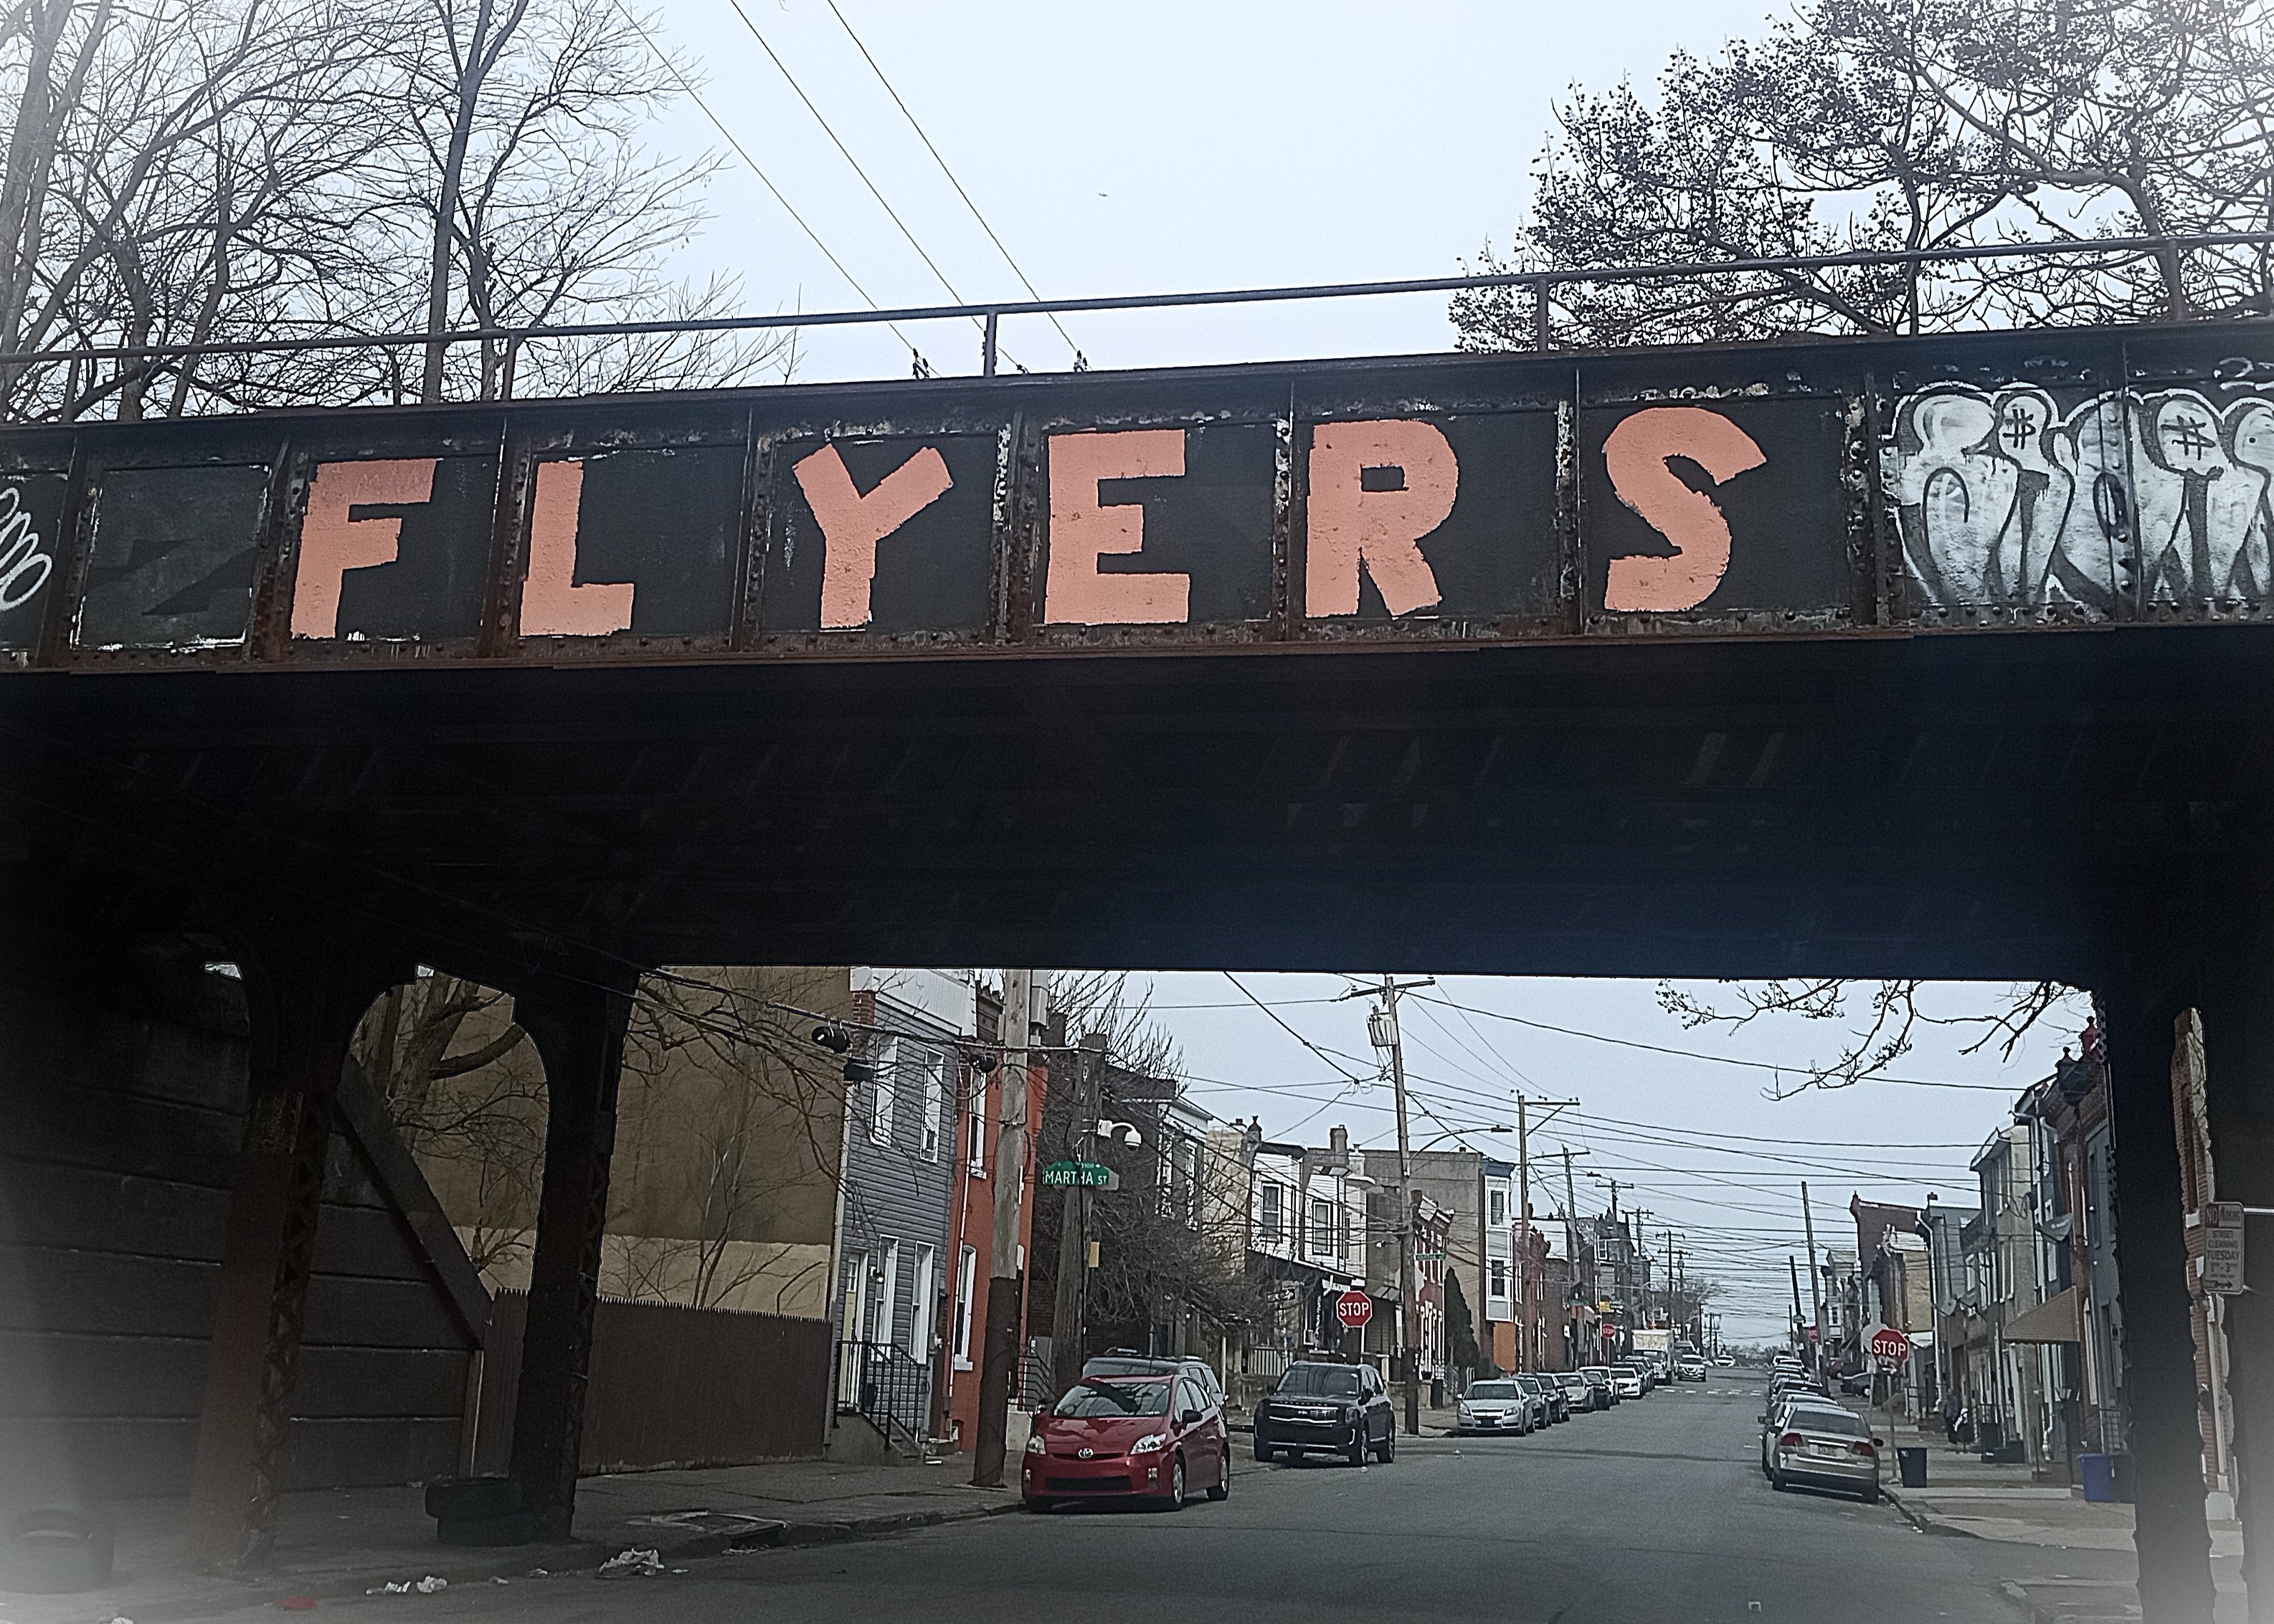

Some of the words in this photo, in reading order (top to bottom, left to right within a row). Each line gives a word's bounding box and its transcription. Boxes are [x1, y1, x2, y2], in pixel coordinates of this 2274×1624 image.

[290, 406, 1766, 640] FLYERS
[1045, 1170, 1094, 1185] MARTHA
[1097, 1175, 1107, 1185] ST
[2206, 1207, 2217, 1223] NO
[2212, 1230, 2233, 1238] STREET
[2208, 1240, 2239, 1249] CLEANING
[2207, 1250, 2240, 1261] TUESDAY
[1340, 1302, 1369, 1316] STOP
[1873, 1339, 1906, 1357] STOP
